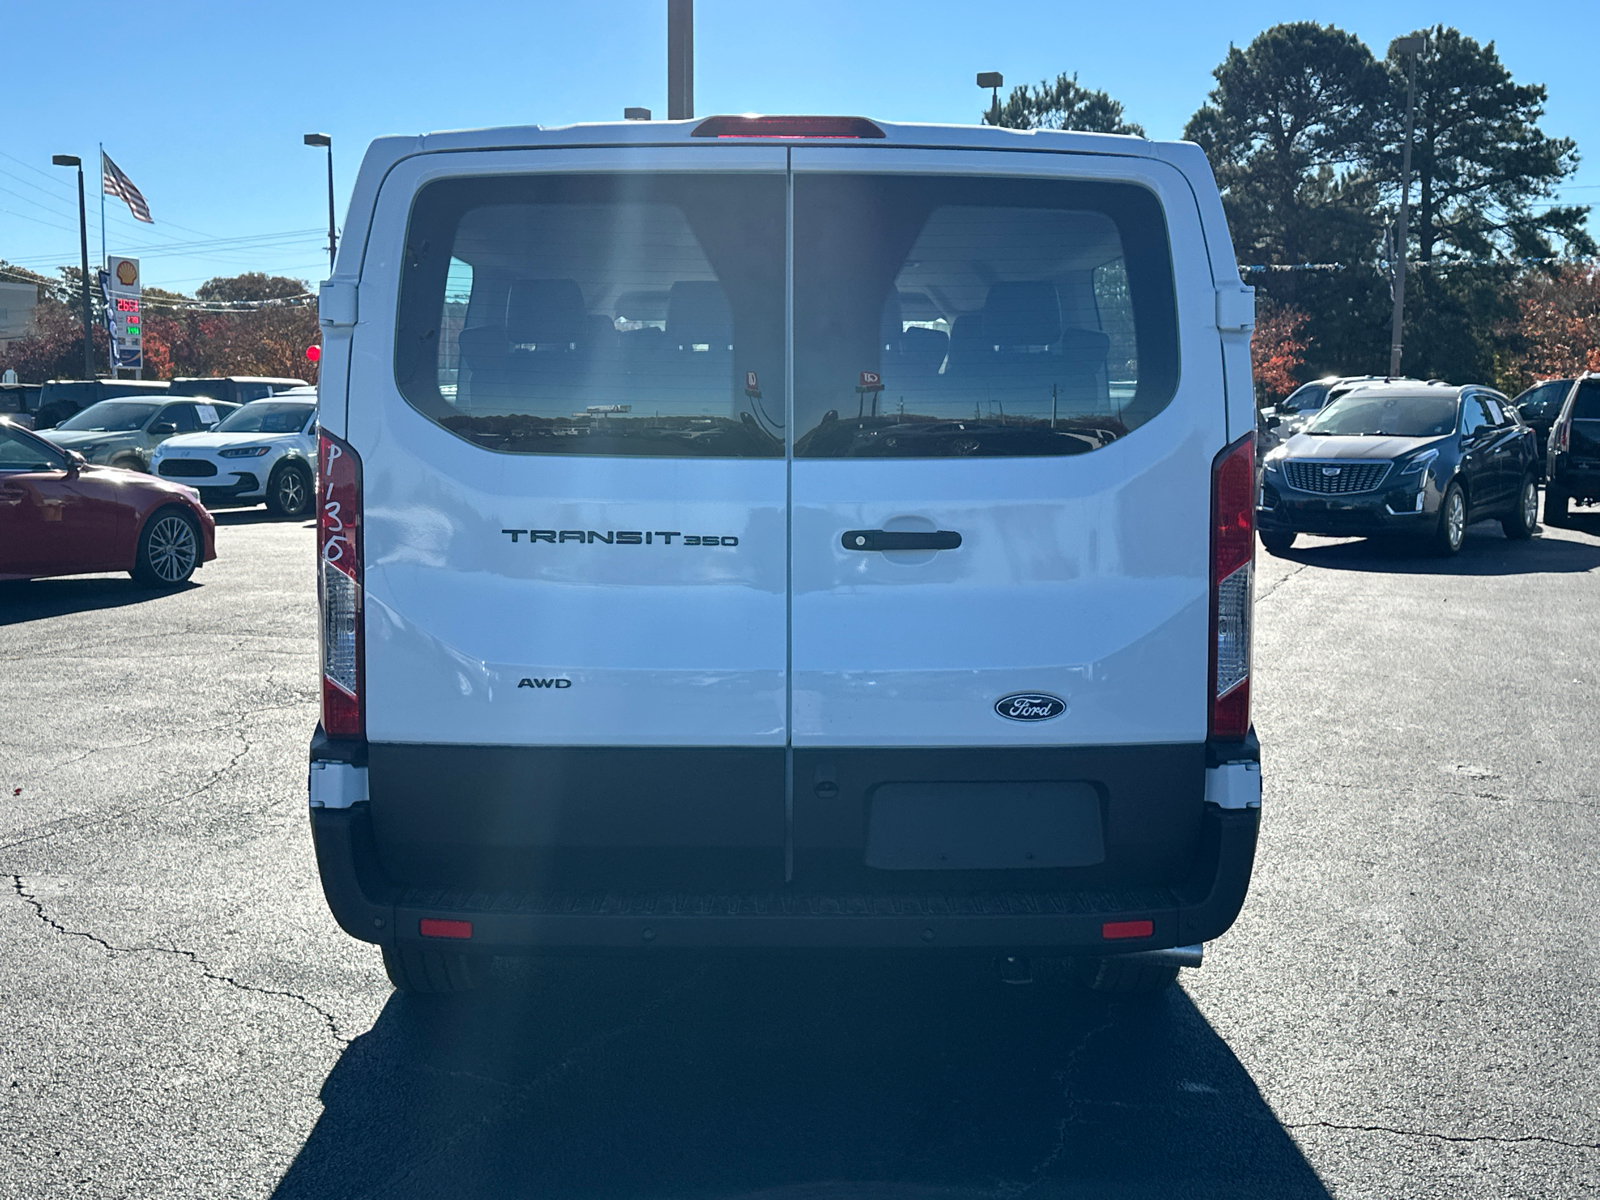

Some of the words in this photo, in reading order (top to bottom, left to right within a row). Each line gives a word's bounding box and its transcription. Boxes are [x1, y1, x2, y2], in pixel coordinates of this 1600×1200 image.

[501, 529, 681, 545] TRANSIT
[683, 535, 739, 547] 350
[517, 678, 572, 689] AWD
[1009, 698, 1053, 716] Ford
